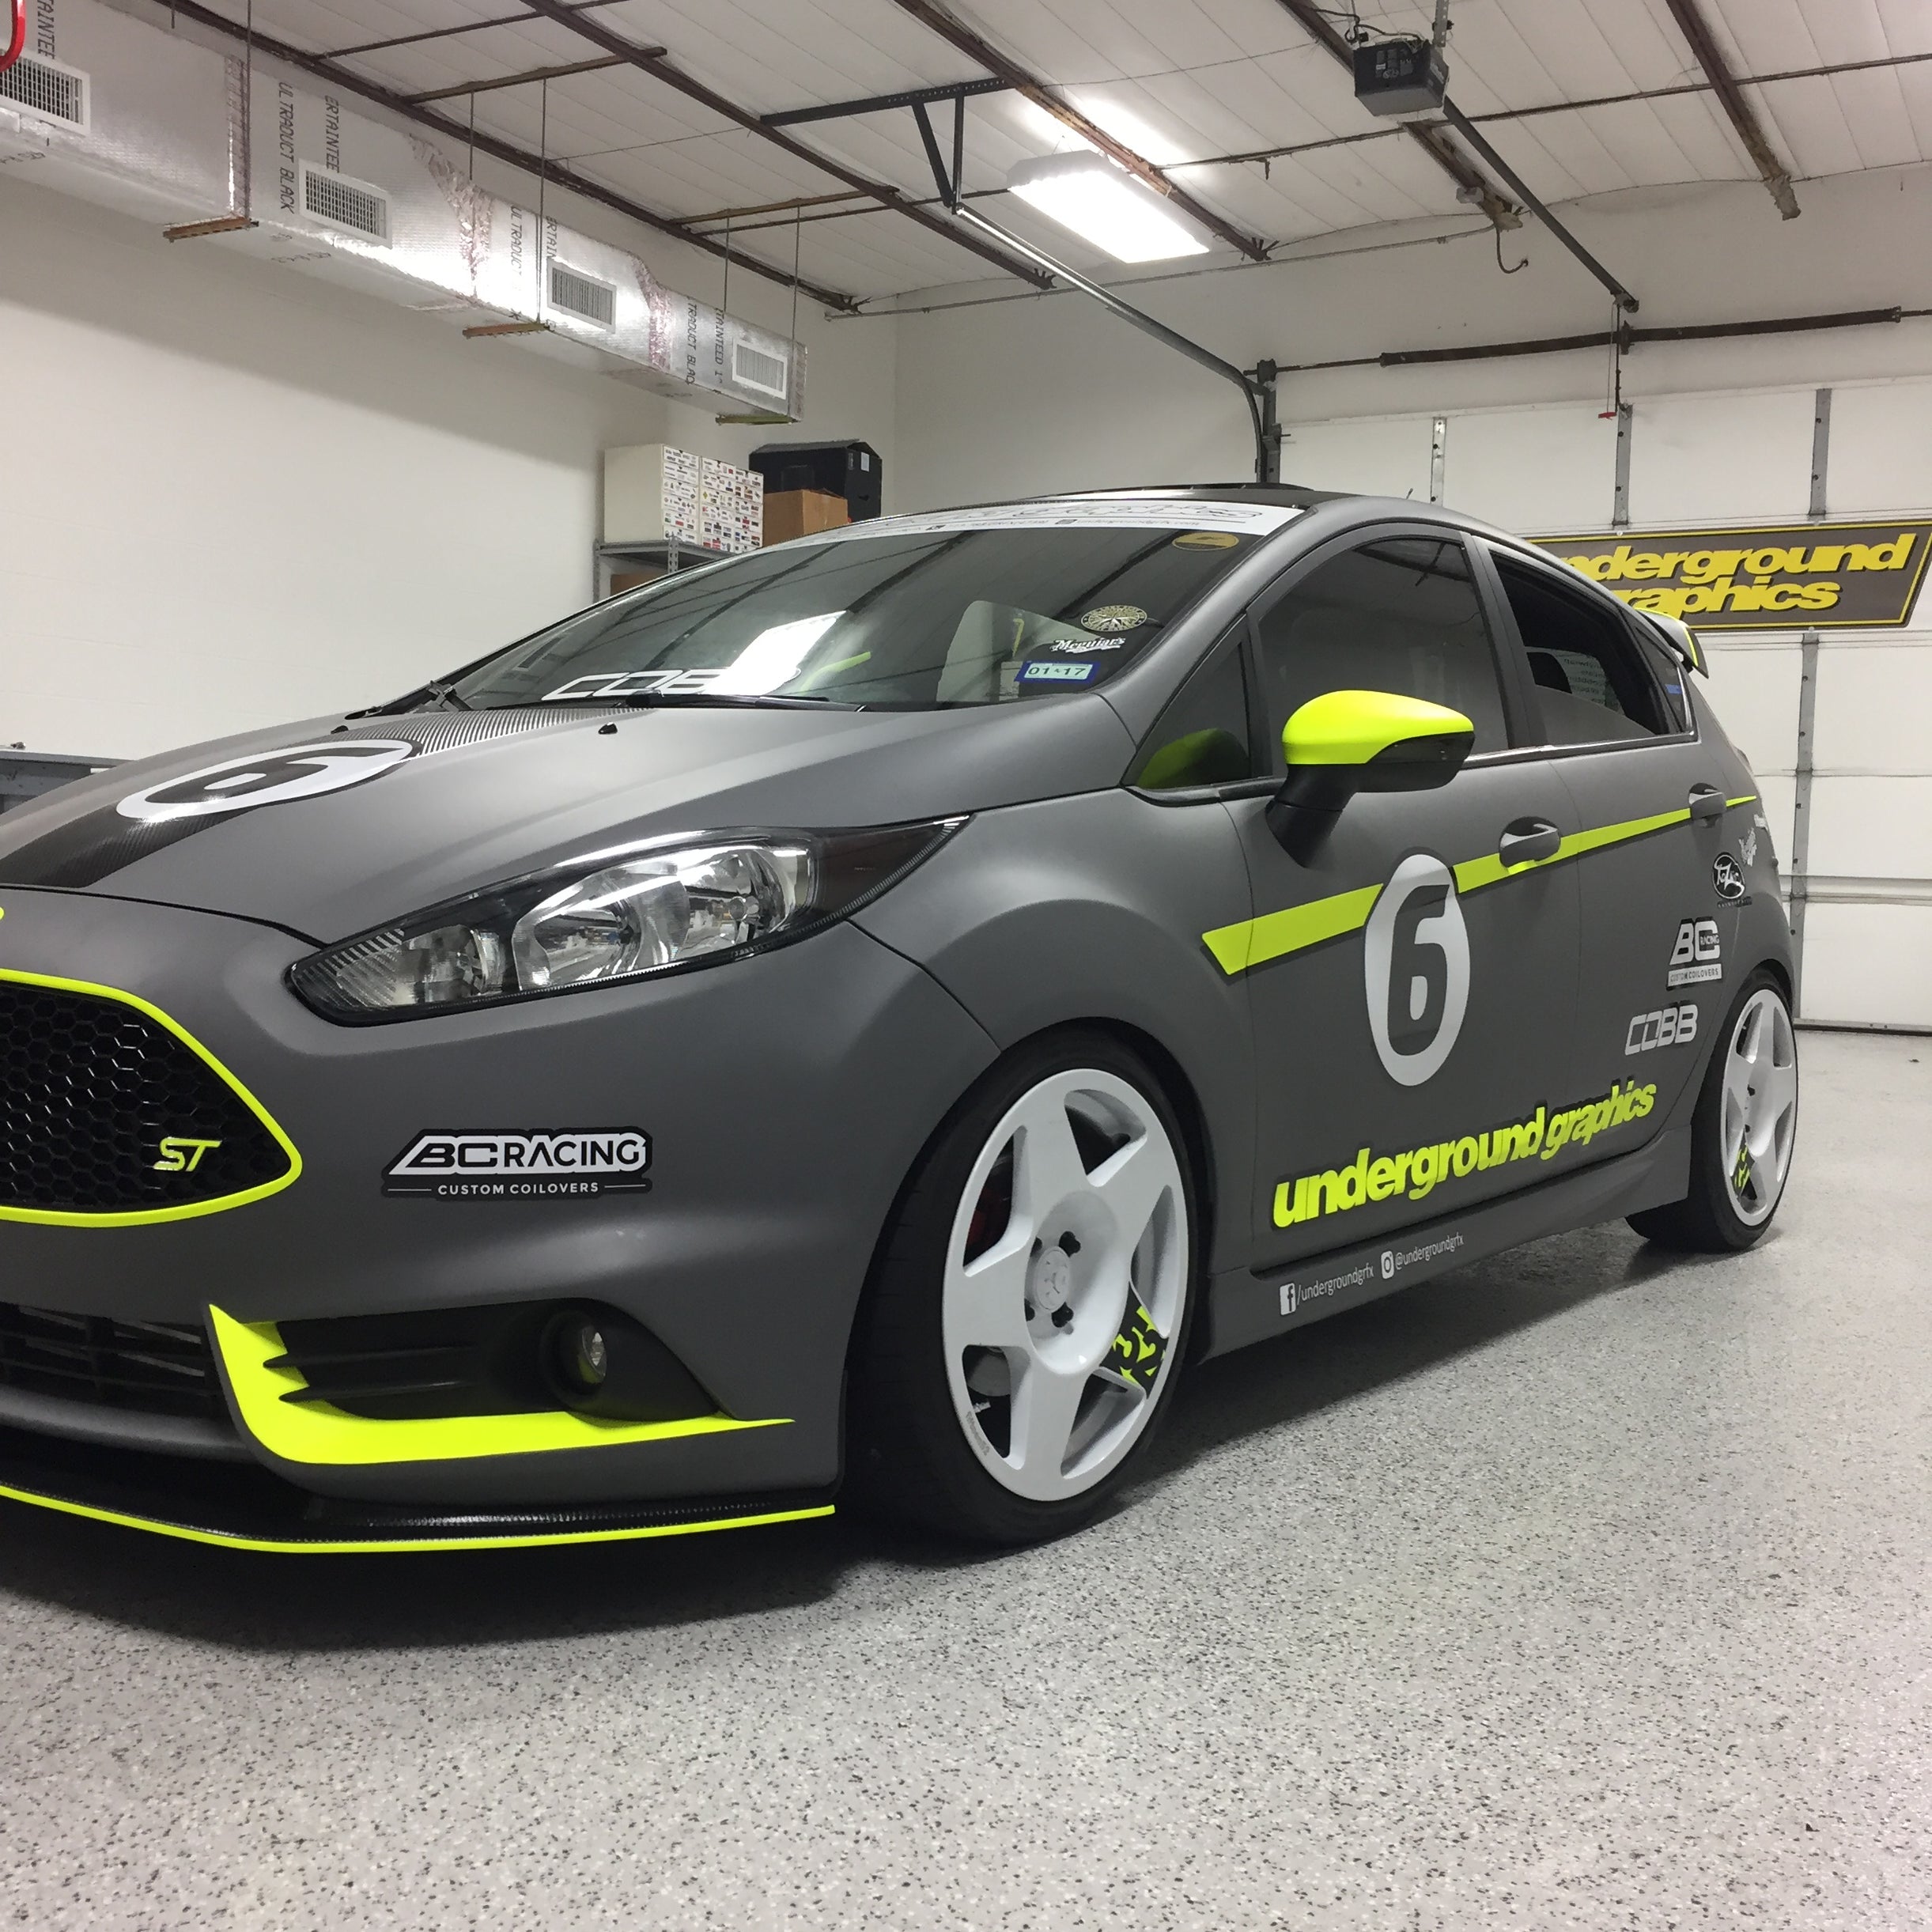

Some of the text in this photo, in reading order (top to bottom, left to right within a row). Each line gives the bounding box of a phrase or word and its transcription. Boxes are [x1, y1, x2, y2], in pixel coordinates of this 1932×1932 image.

[278, 81, 294, 163] ULTRADUCT
[279, 167, 294, 214] BLACK
[142, 745, 406, 806] 6
[1669, 920, 1721, 966] BC
[1625, 1004, 1699, 1056] COBB
[153, 1137, 222, 1172] ST
[1272, 1080, 1658, 1228] underground graphics
[437, 1182, 599, 1196] CUSTOM COILOVERS
